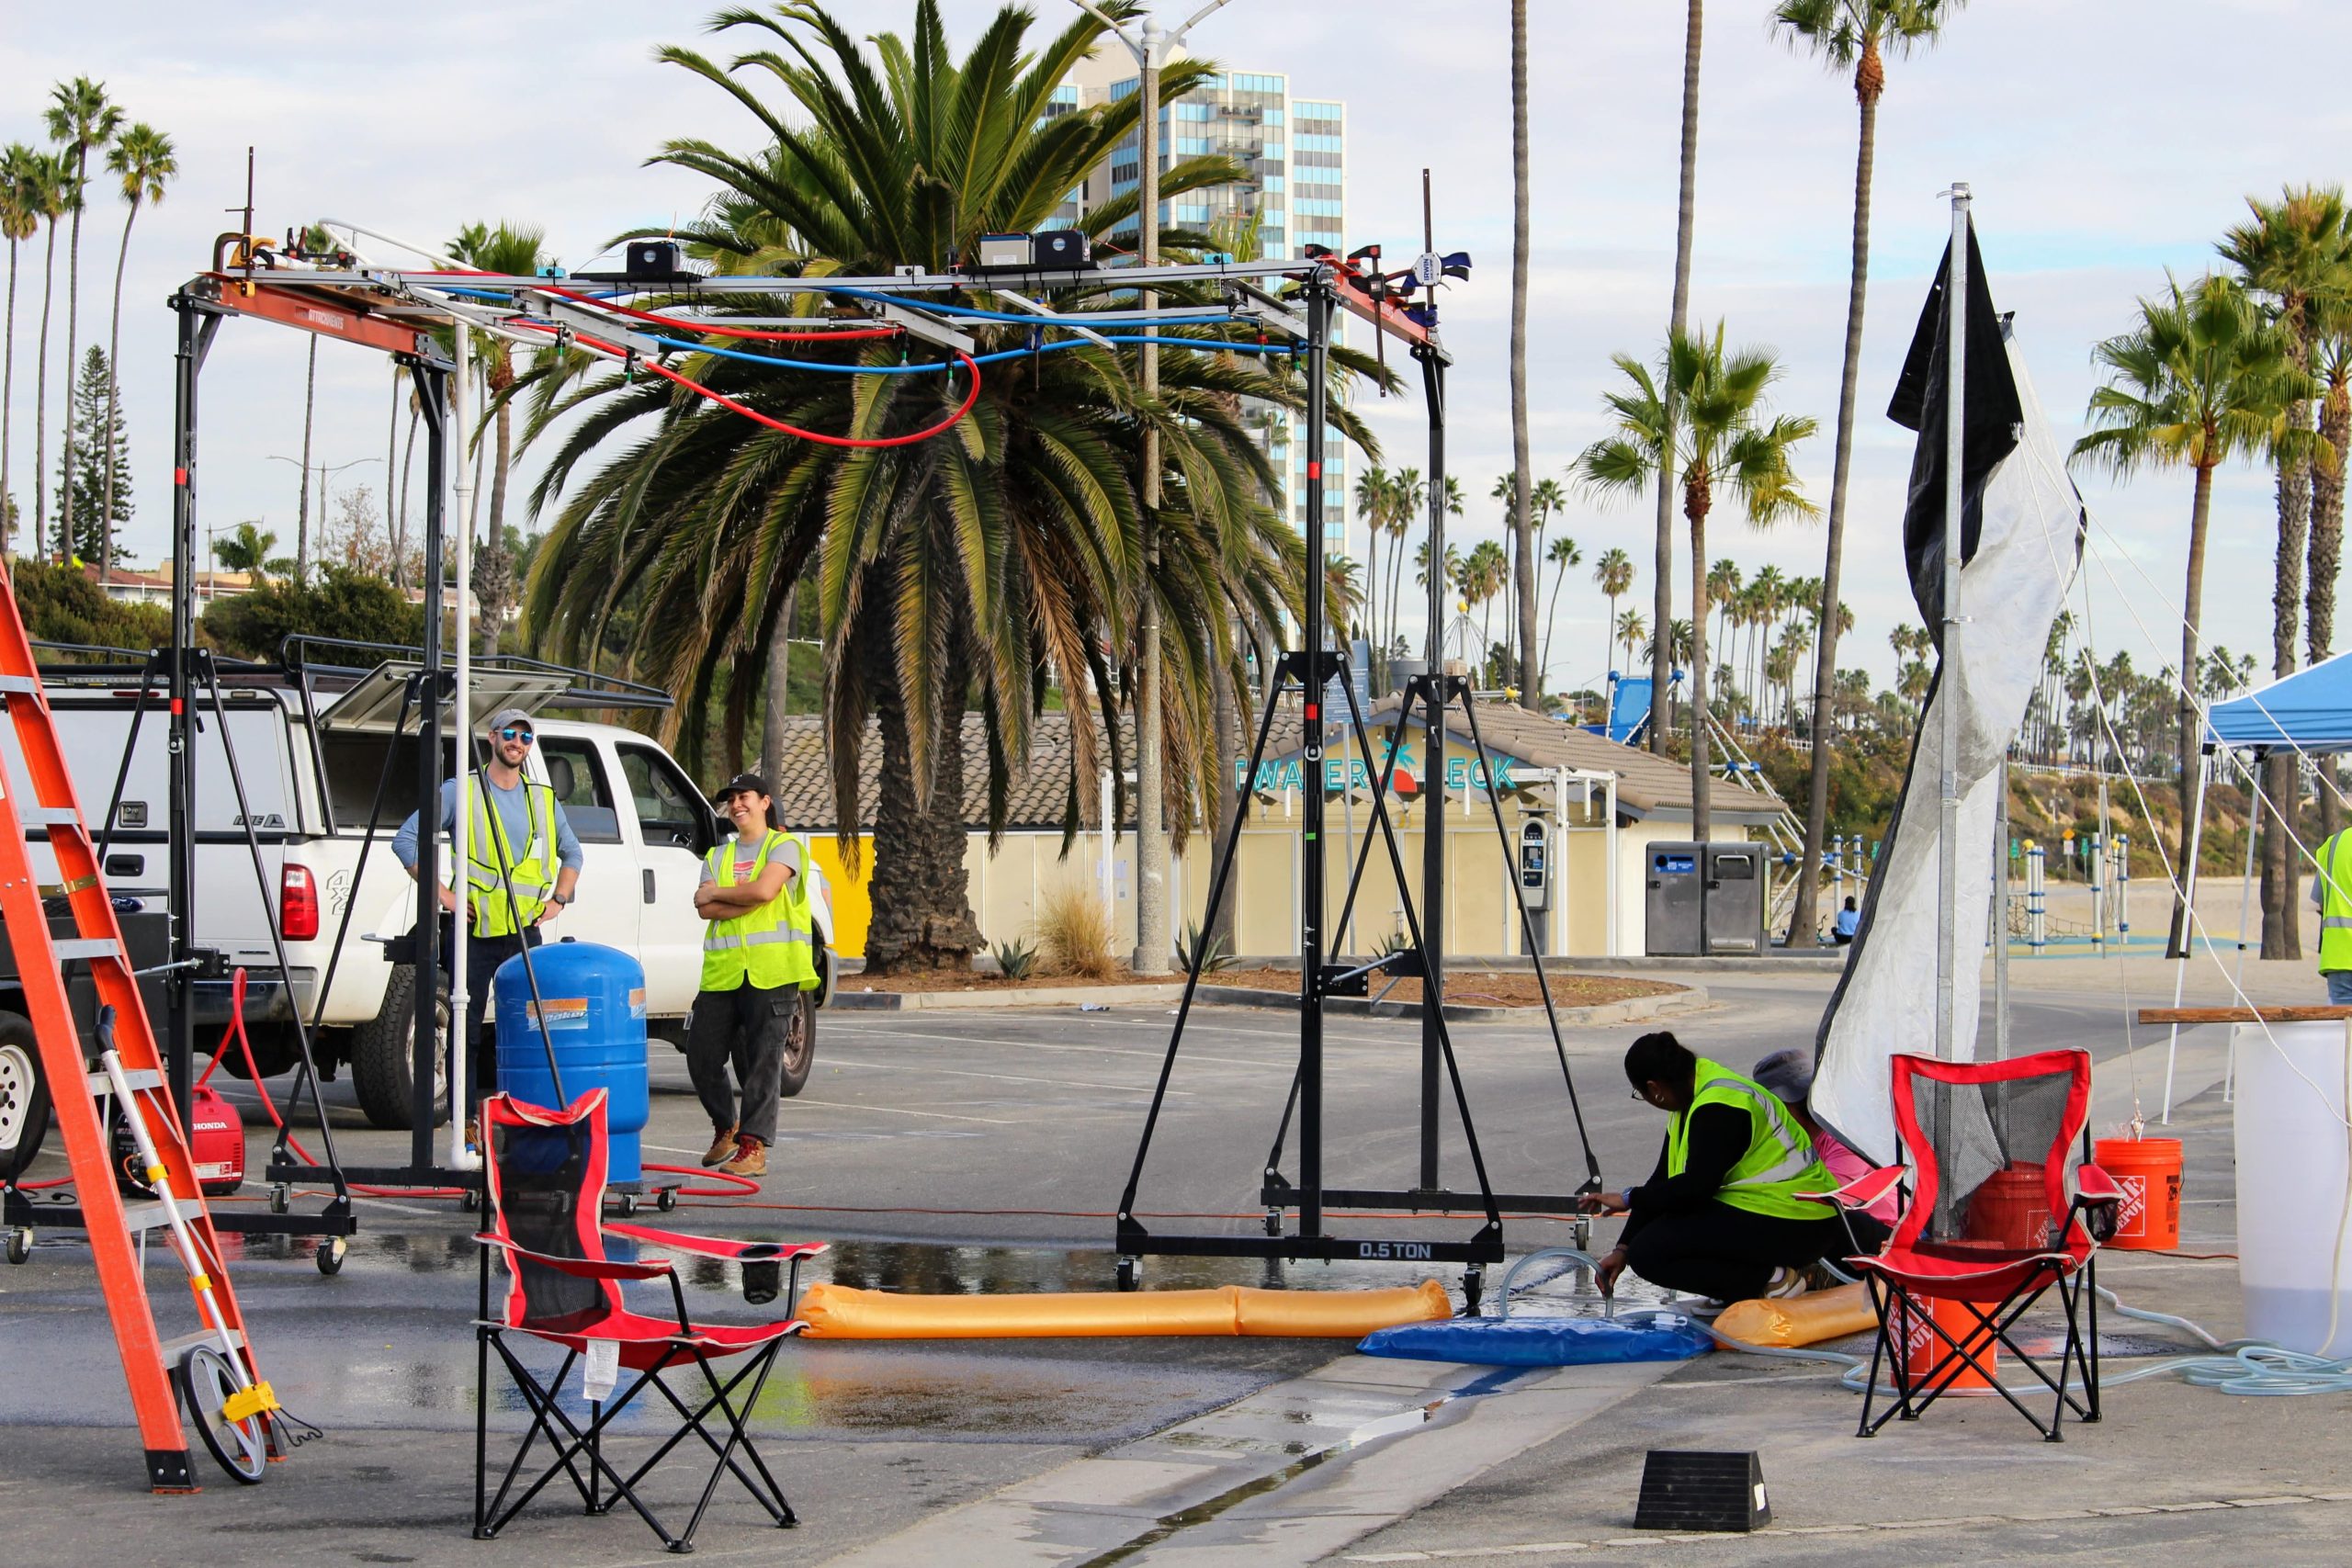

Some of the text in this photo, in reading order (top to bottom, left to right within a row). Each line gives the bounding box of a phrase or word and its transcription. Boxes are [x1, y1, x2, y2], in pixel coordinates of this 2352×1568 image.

[193, 1122, 228, 1131] HONDA
[1360, 1242, 1431, 1258] 0.5 TON
